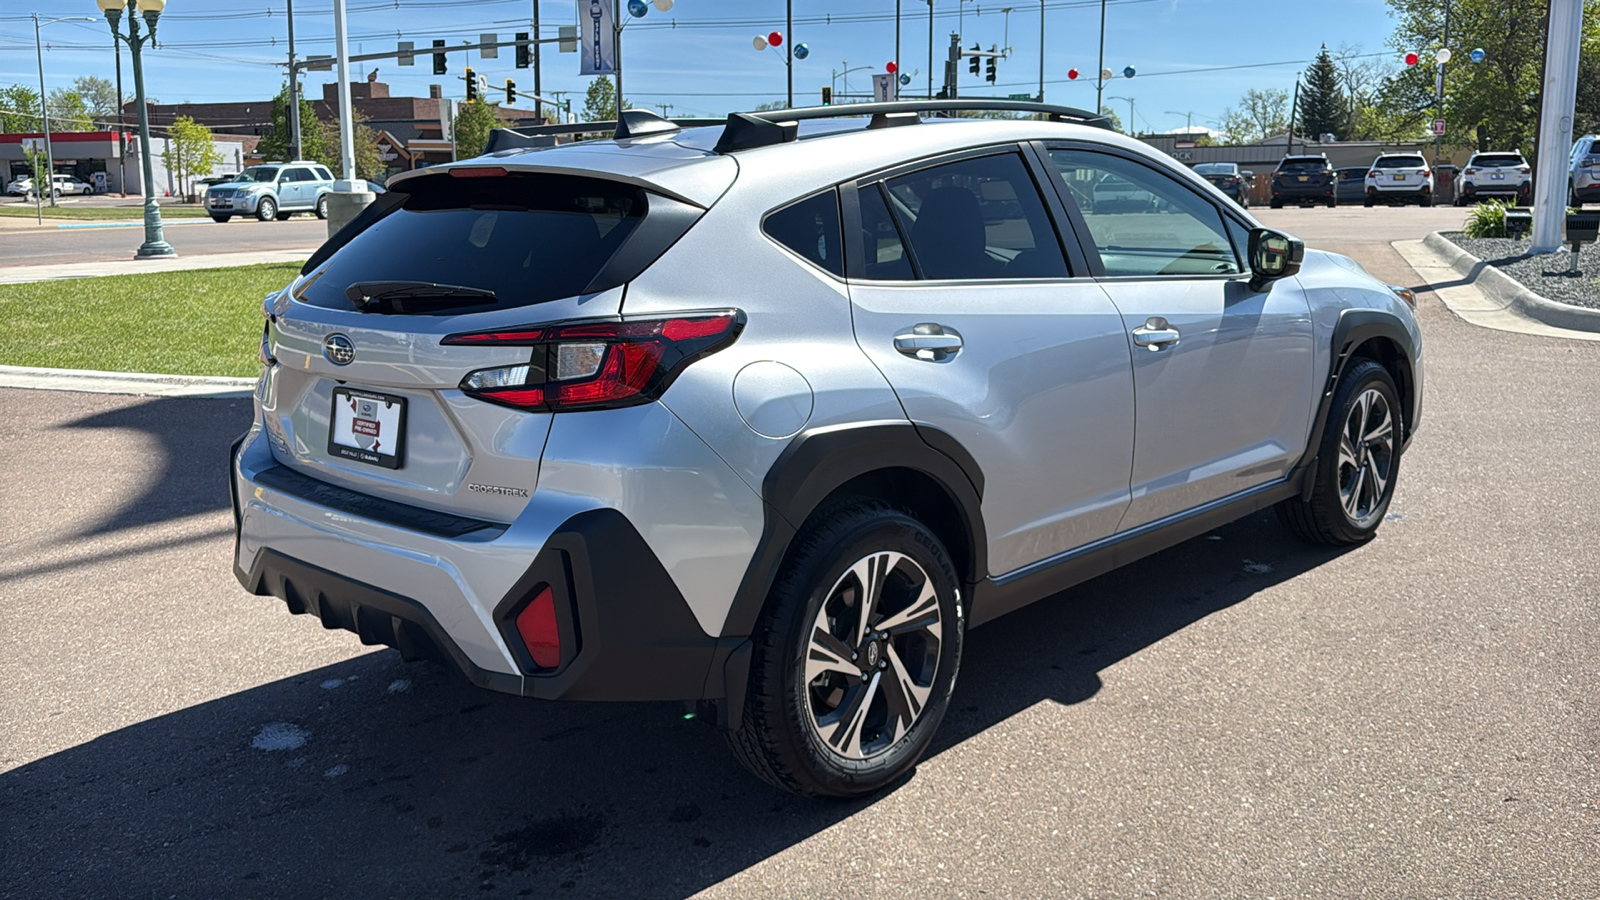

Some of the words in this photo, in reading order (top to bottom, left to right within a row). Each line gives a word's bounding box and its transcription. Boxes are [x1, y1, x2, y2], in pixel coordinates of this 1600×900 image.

[356, 420, 376, 429] CERTIFIED
[354, 426, 377, 435] PRE-OWNED
[467, 483, 528, 498] CROSSTREK
